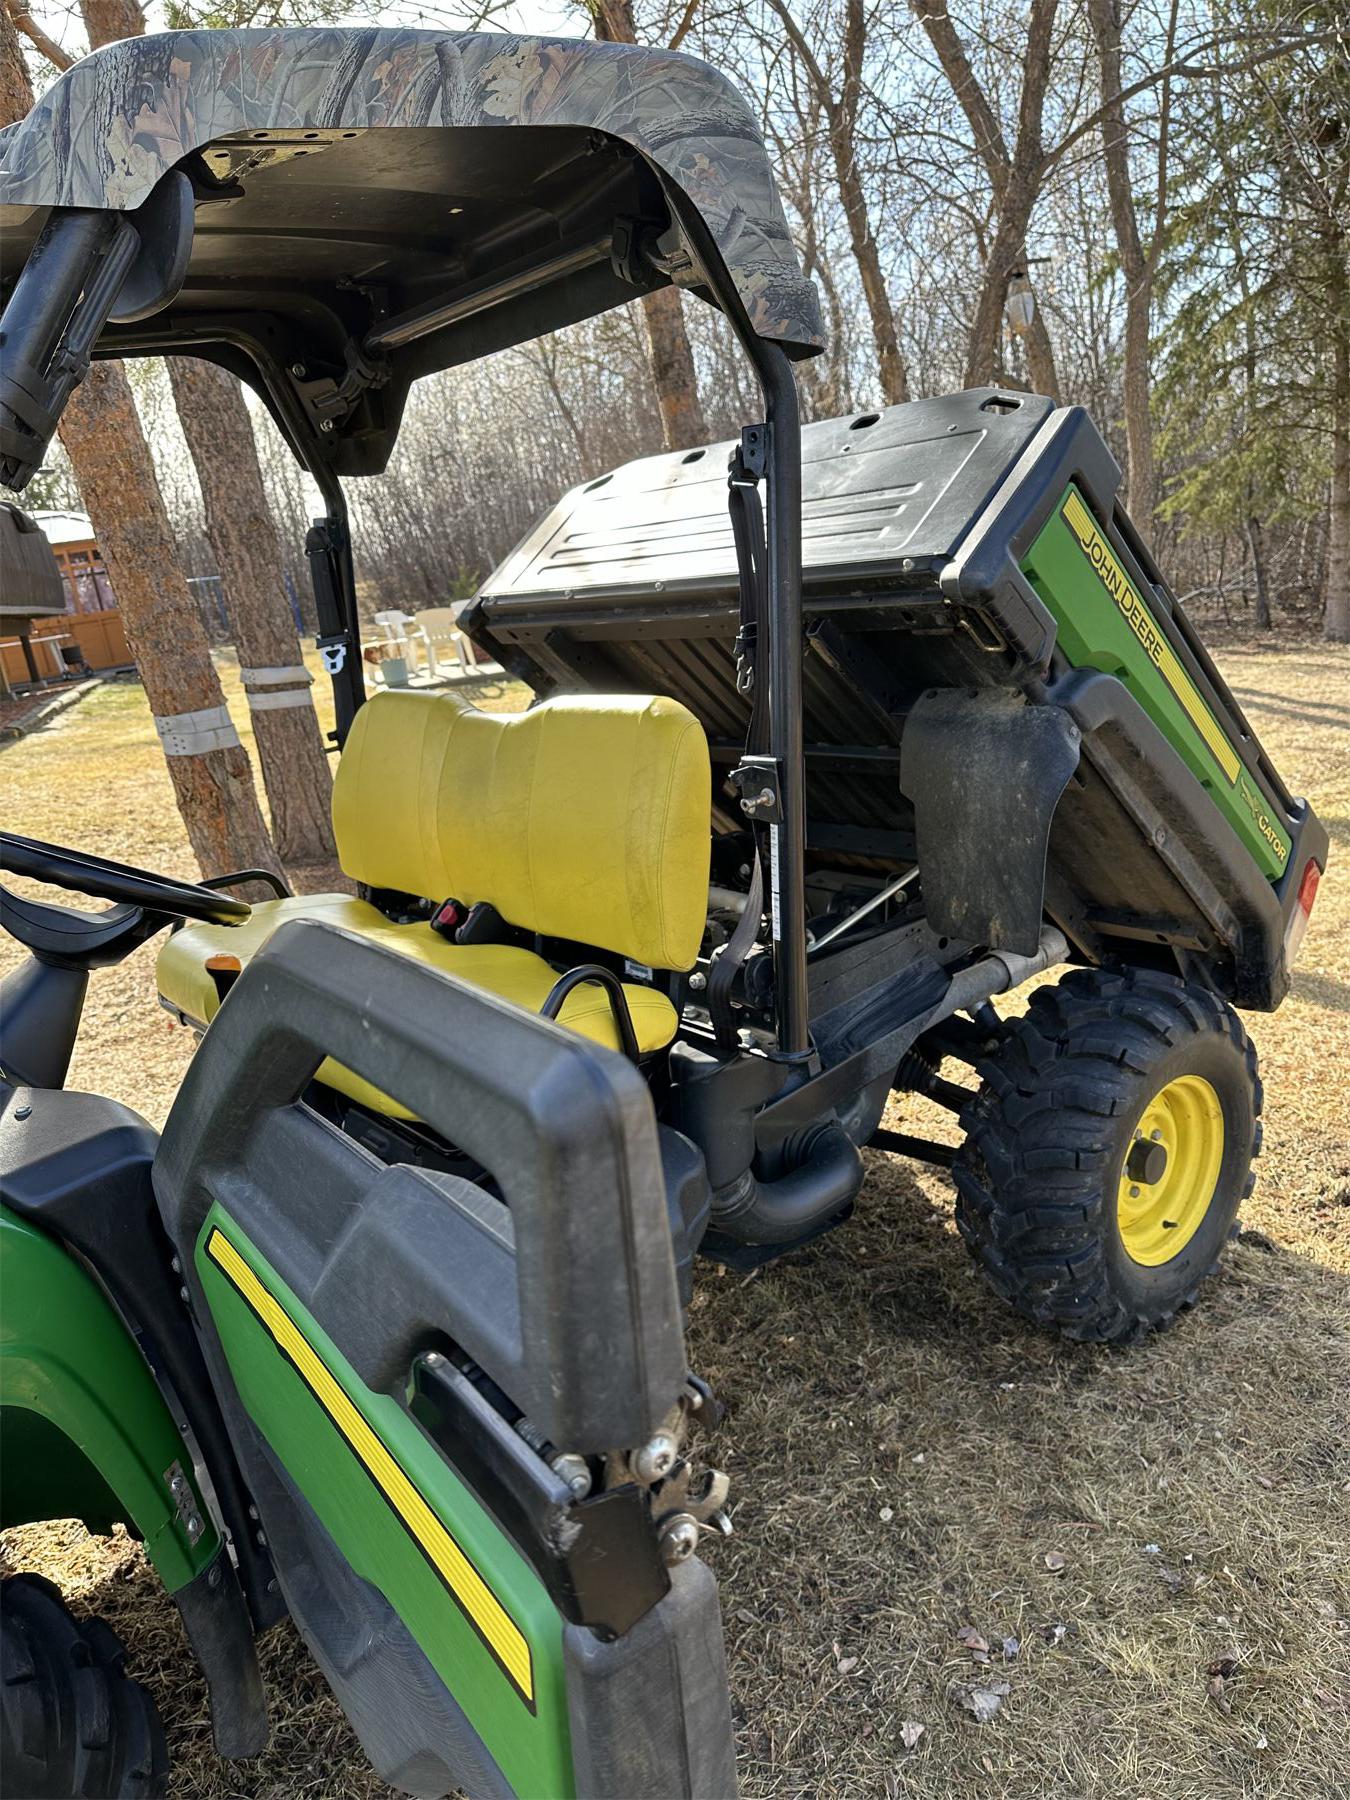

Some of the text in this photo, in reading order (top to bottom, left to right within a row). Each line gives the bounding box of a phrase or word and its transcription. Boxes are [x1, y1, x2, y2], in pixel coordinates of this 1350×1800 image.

[1081, 532, 1163, 663] JOHN DEERE
[1258, 815, 1287, 861] GATOR
